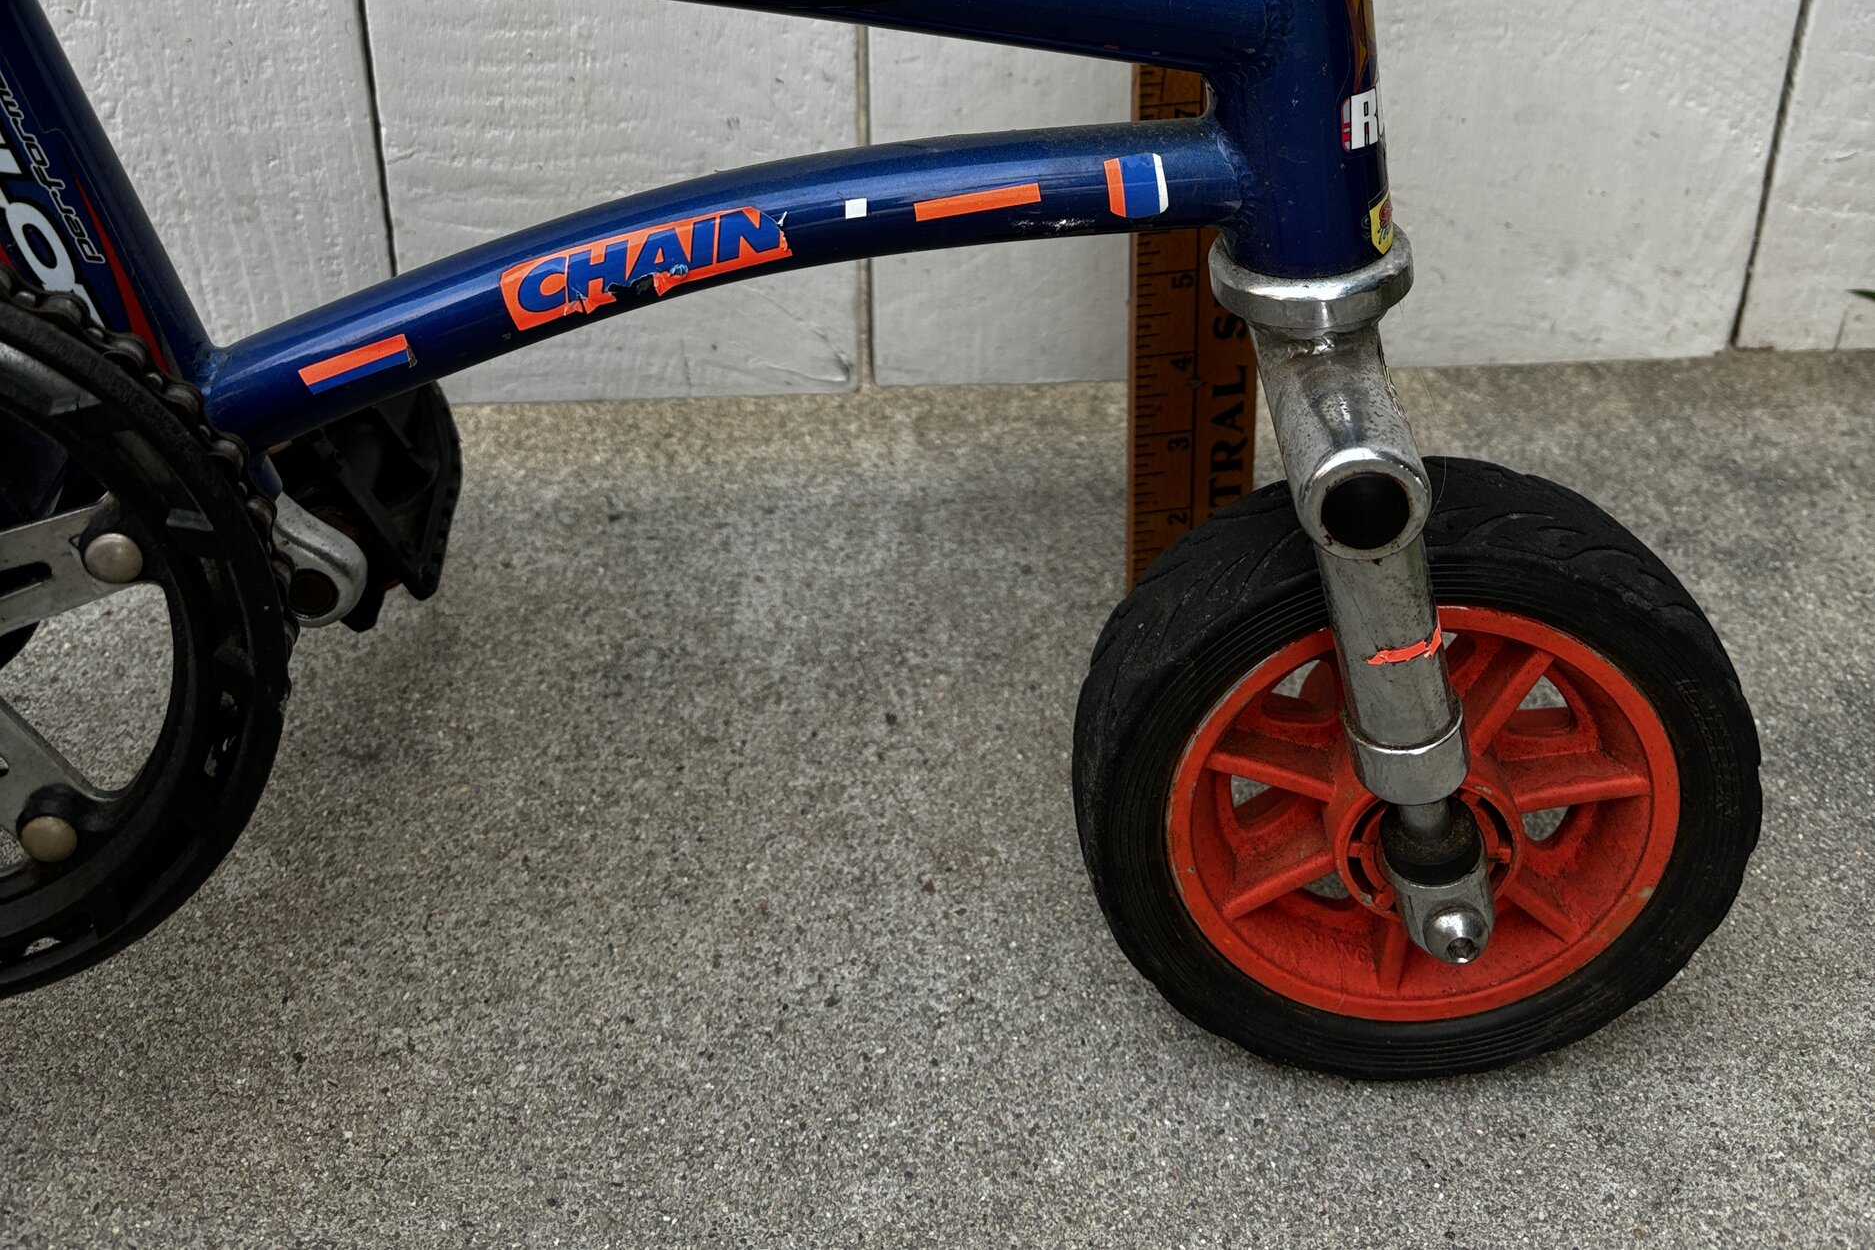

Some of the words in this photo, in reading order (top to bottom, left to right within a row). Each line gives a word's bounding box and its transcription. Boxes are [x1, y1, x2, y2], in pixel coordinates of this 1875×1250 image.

[516, 207, 785, 314] CHAIN
[1171, 273, 1194, 289] 5
[1169, 356, 1193, 371] 4
[1167, 436, 1190, 452] 3
[1207, 364, 1248, 519] TRAL
[1166, 510, 1189, 525] 2
